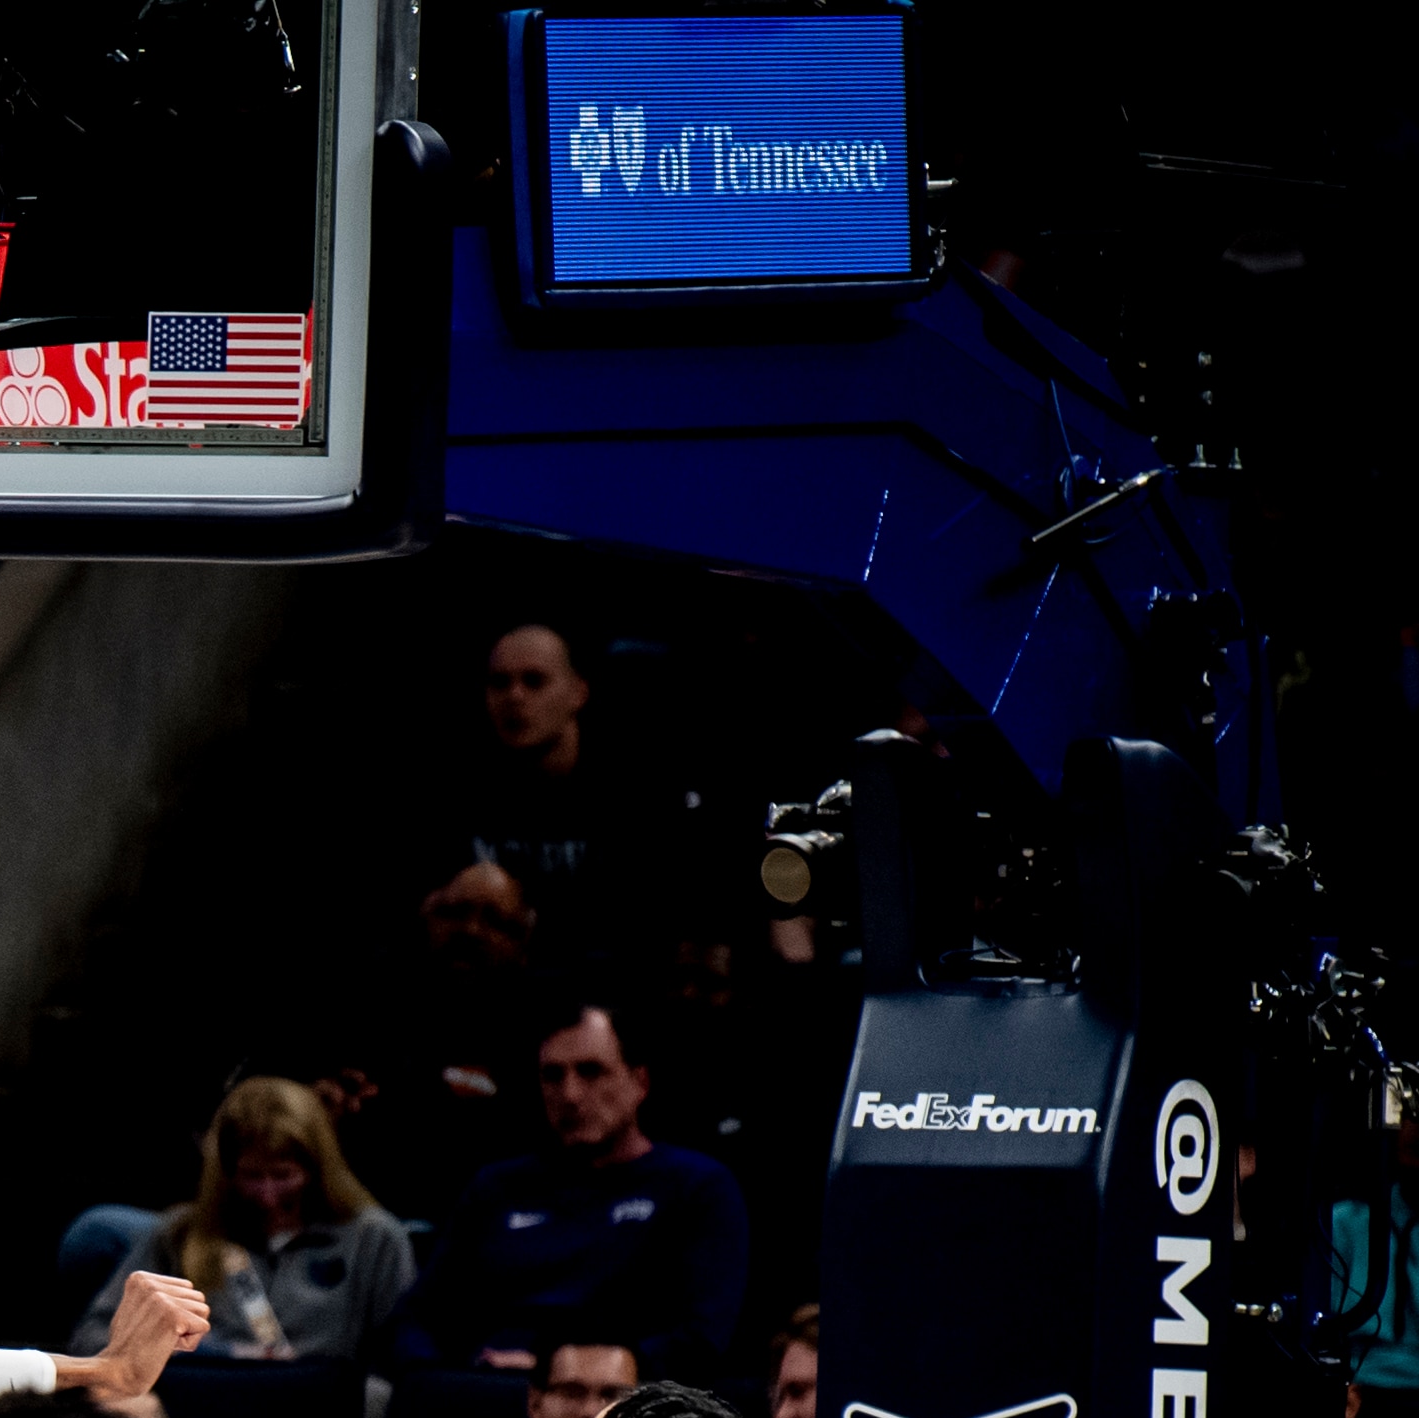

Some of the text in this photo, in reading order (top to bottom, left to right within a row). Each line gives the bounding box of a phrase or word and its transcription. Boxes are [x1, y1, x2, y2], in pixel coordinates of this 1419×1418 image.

[657, 124, 888, 195] of Tennessee
[73, 341, 149, 427] Sta
[852, 1091, 1101, 1133] FedExForum
